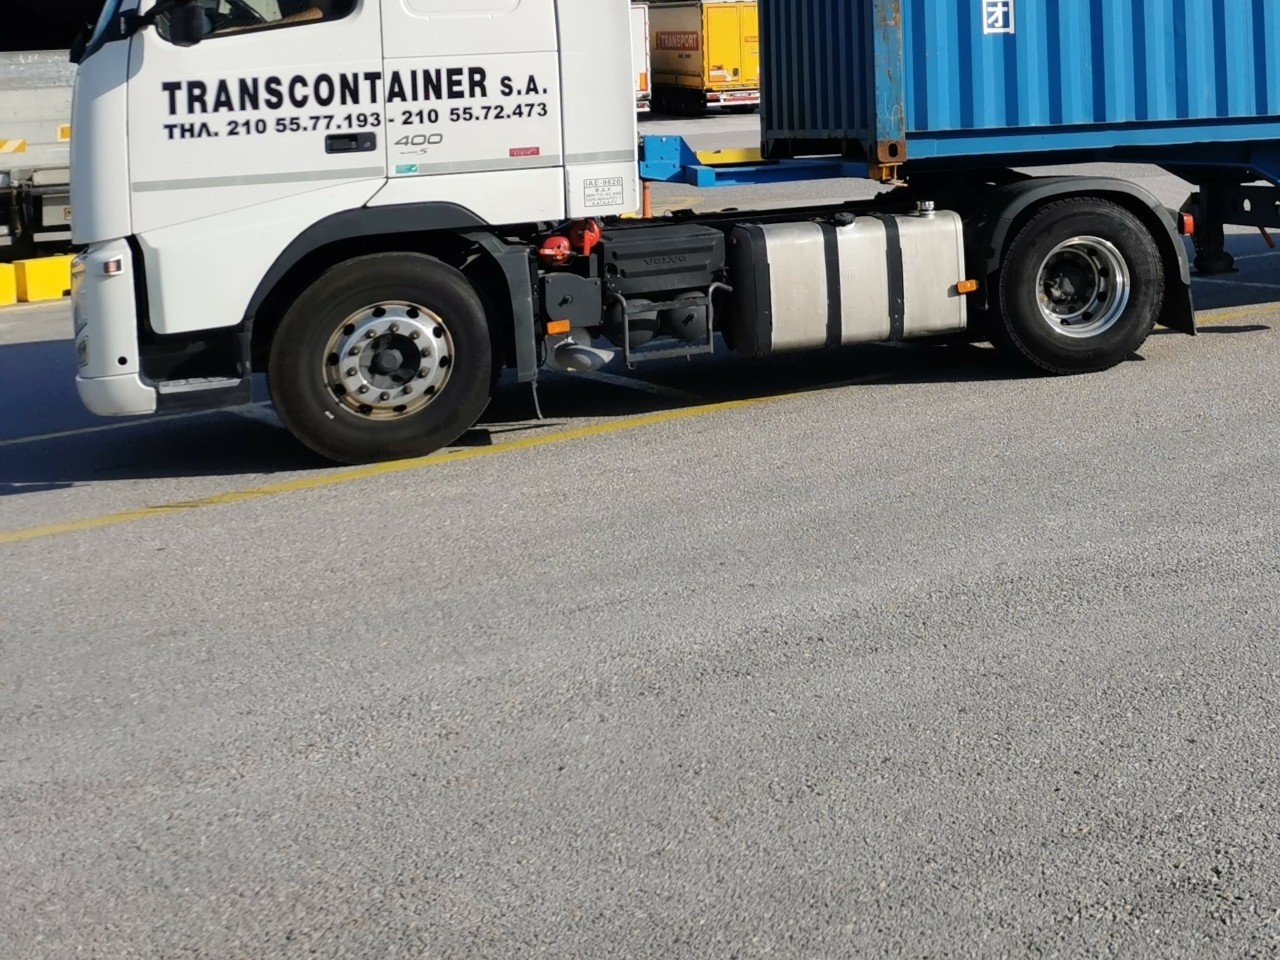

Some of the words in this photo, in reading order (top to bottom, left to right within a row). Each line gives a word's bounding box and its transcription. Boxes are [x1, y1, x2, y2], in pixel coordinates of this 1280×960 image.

[660, 33, 698, 48] TRANSPORT
[161, 66, 488, 116] TRANSCONTAINER
[500, 74, 548, 97] S.A.
[163, 122, 219, 140] ΤΗΛ.
[226, 118, 267, 137] 210
[274, 112, 382, 133] 55.77.193
[401, 109, 439, 125] 210
[449, 102, 548, 122] 55.72.473
[393, 132, 444, 147] 400
[643, 255, 687, 266] VOLVO
